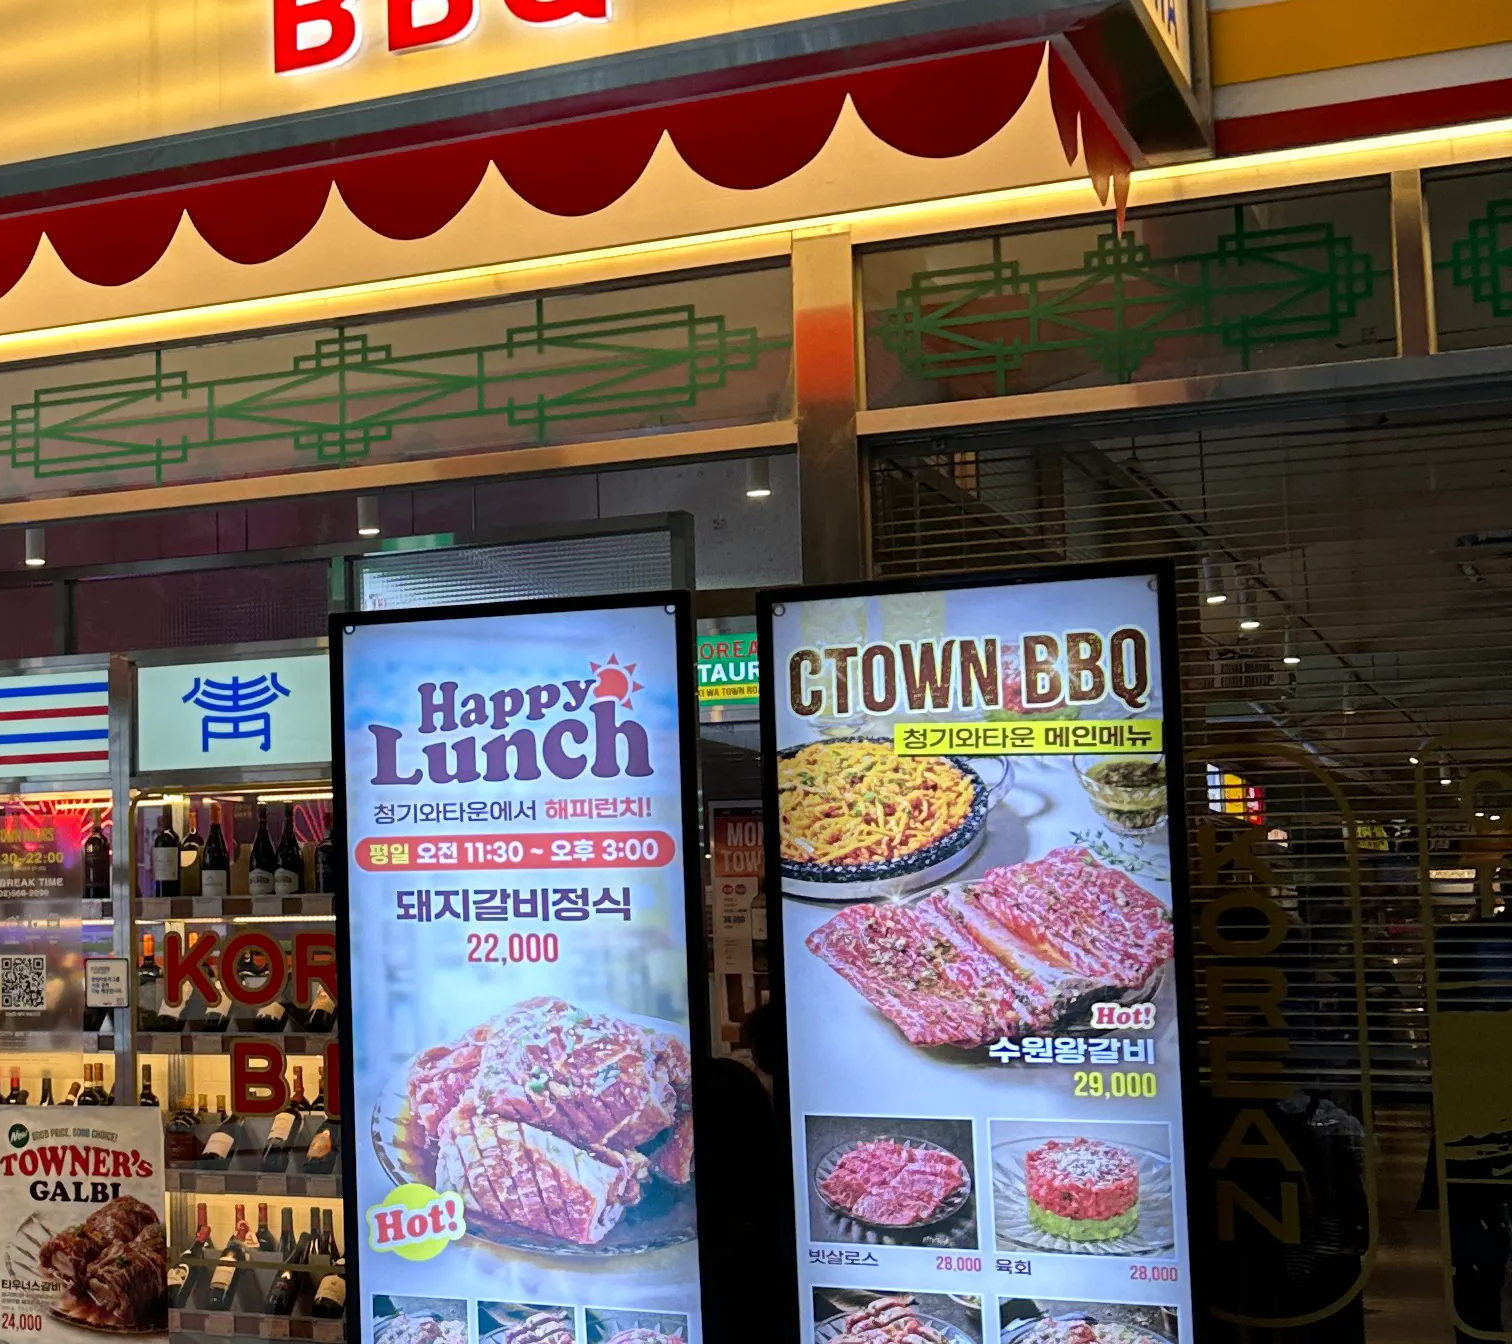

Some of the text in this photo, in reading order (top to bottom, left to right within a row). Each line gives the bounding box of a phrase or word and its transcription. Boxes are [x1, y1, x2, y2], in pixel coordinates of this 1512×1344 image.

[789, 628, 1148, 716] CTOWN BBQ
[418, 680, 596, 734] Happy
[368, 700, 654, 785] Lunch
[903, 725, 1152, 750] 청기와타운 메인메뉴
[374, 797, 652, 824] 청기와타운에서 해피런치!
[369, 838, 659, 866] 평일 오전 11:30 오후 3:00
[0, 878, 35, 887] BREAK
[38, 877, 64, 887] TIME
[396, 886, 632, 922] 돼지갈비정식
[467, 933, 559, 966] 22,000
[1096, 1006, 1152, 1025] Hot!
[989, 1037, 1155, 1064] 수원왕갈비
[1074, 1072, 1157, 1099] 29,000
[30, 1181, 121, 1202] GALBI
[374, 1199, 458, 1244] Hot!
[936, 1255, 982, 1273] 28,000
[996, 1259, 1178, 1282] 육회 28,000
[1, 1313, 42, 1331] 24,000
